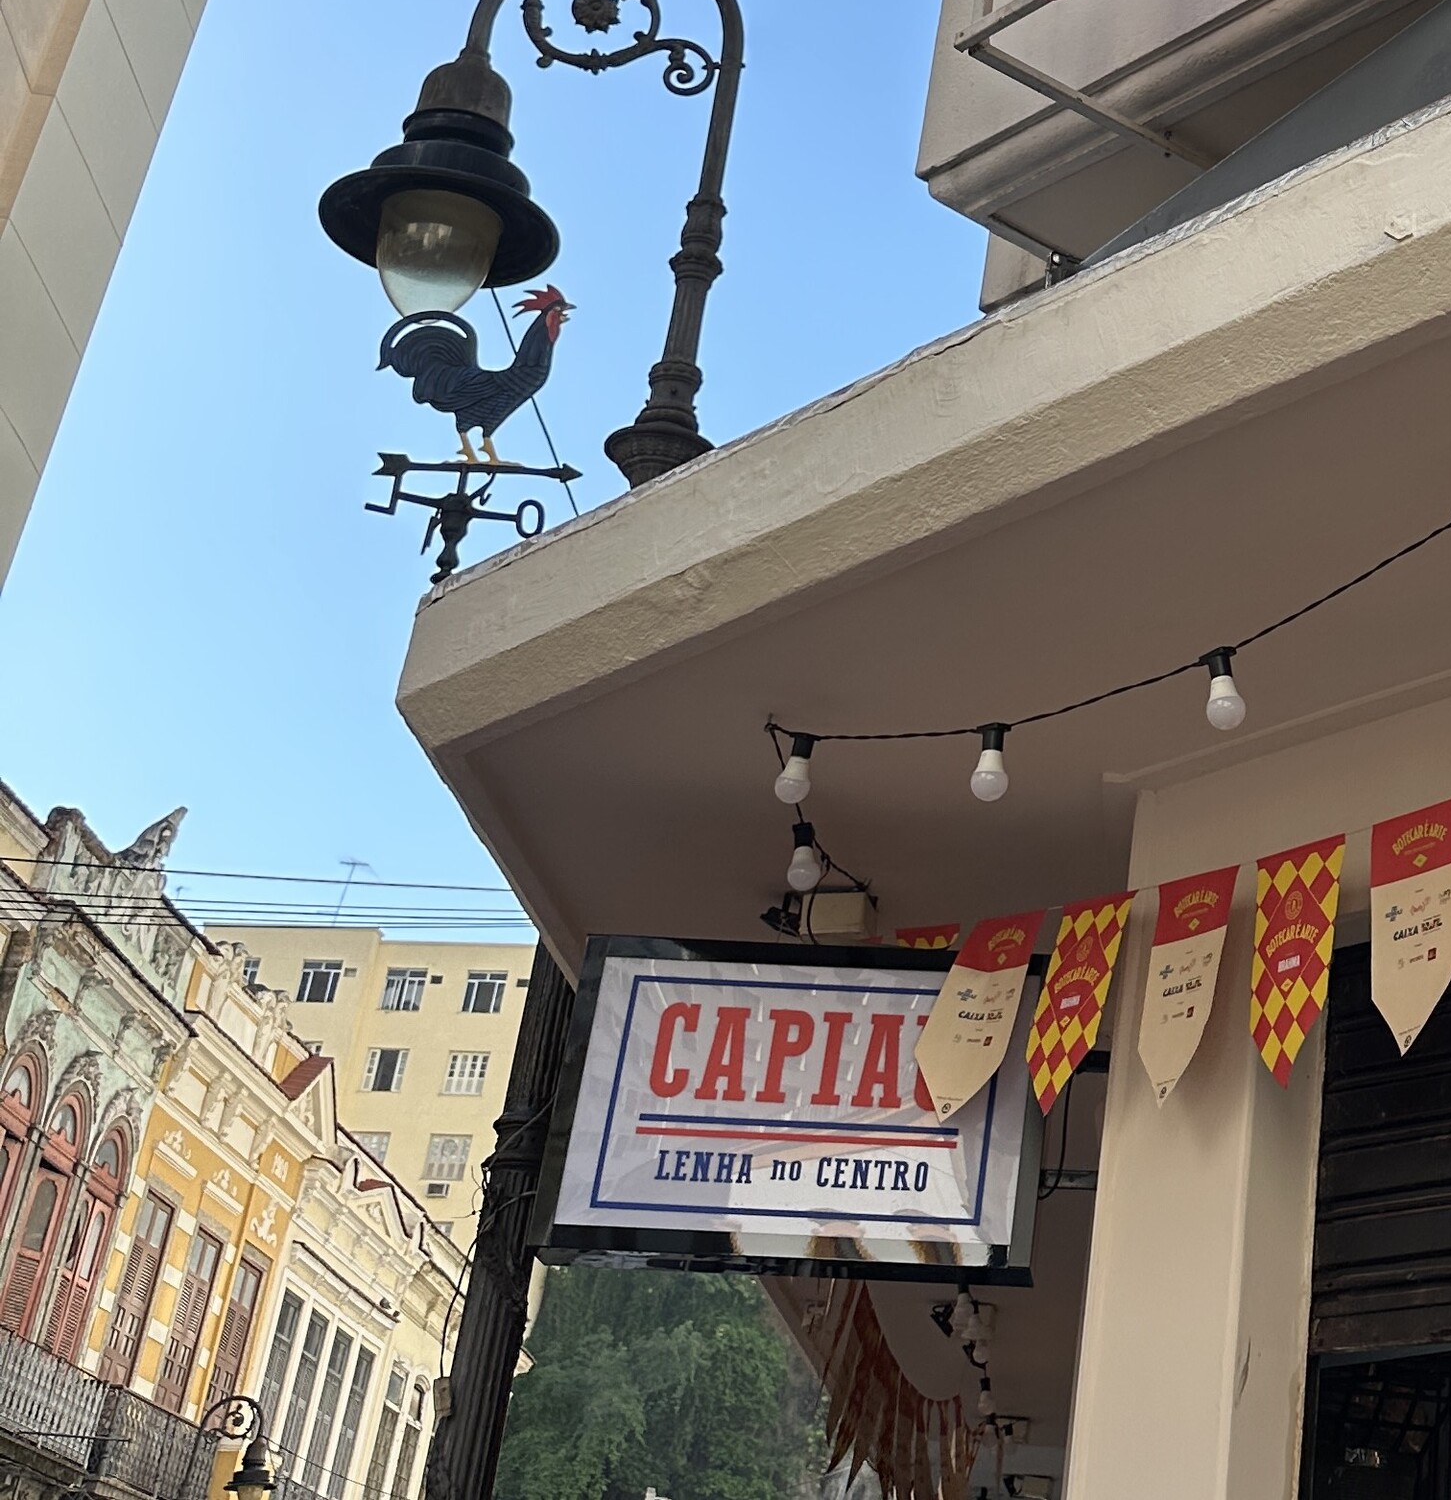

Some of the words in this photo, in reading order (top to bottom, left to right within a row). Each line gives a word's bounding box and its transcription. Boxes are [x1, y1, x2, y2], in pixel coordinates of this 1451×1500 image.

[1393, 925, 1419, 942] CAIXA
[649, 1001, 938, 1113] CAPIA
[654, 1149, 753, 1185] LENHA
[770, 1158, 802, 1182] no
[816, 1156, 929, 1193] CENTRO
